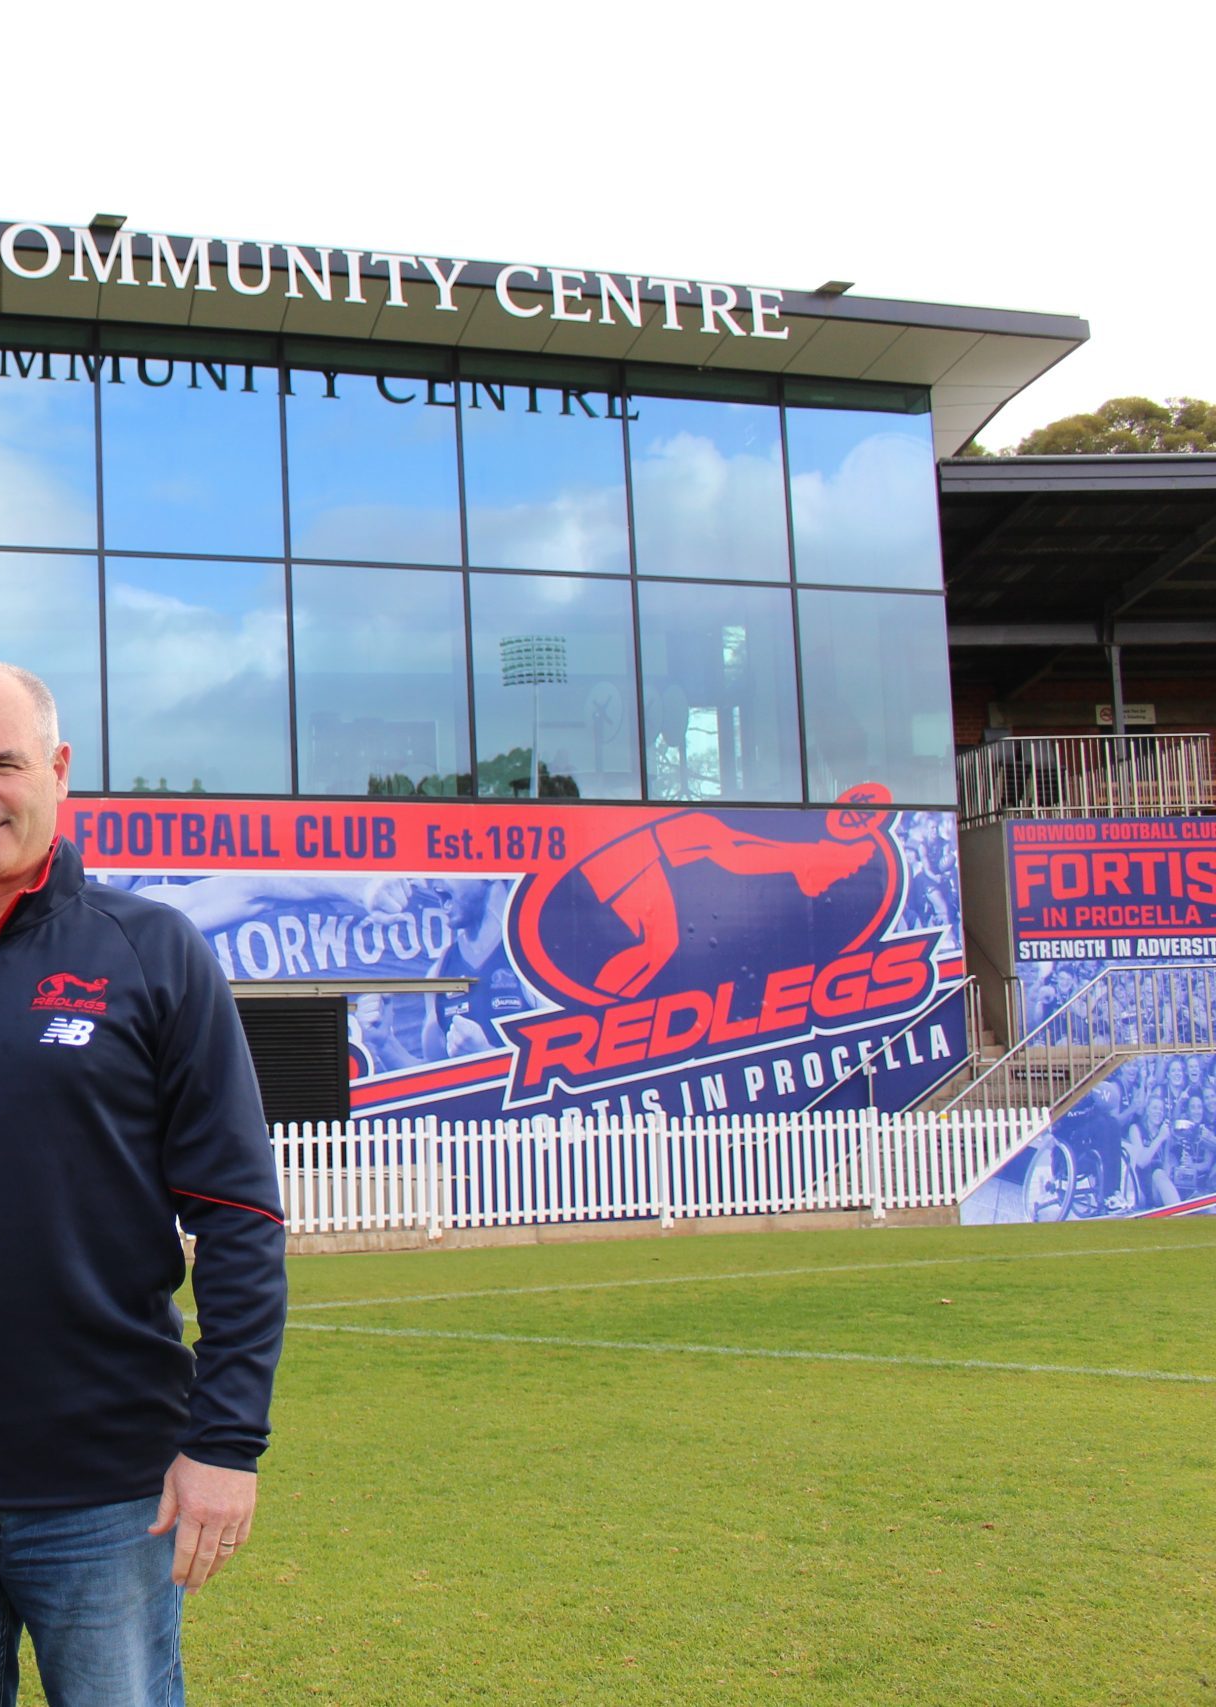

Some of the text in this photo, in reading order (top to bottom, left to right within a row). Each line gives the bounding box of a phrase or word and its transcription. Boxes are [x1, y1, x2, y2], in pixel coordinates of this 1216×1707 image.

[495, 263, 790, 340] CENTRE
[74, 811, 281, 859] FOOTBALL
[295, 815, 397, 860] CLUB
[427, 825, 567, 861] Est.1878
[1013, 823, 1096, 842] NORWOOD
[1102, 822, 1177, 841] FOOTBALL
[1014, 851, 1216, 909] FORTIS
[1043, 904, 1202, 928] IN PROCELLA
[1019, 939, 1106, 960] STRENGTH
[1112, 938, 1130, 957] IN
[31, 997, 107, 1011] REDLEGS
[518, 940, 928, 1087] REDLEGS
[680, 1073, 728, 1116] IN
[744, 1023, 951, 1101] PROCELLA
